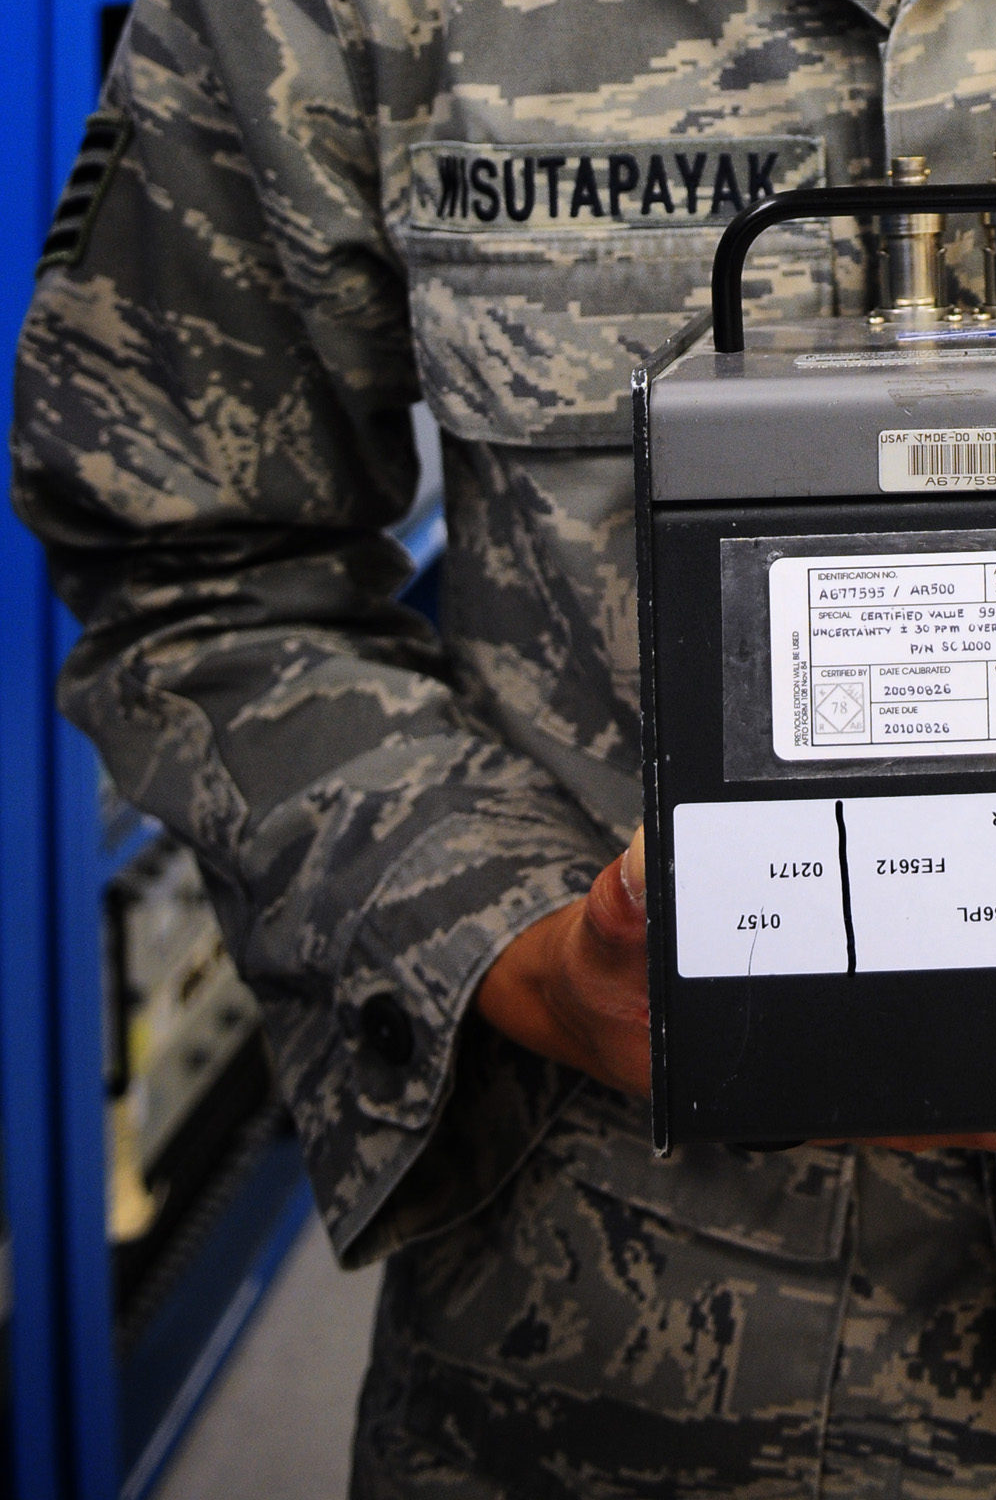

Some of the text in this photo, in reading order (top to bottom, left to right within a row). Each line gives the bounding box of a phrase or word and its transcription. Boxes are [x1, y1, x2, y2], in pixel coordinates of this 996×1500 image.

[881, 434, 909, 443] USAF
[918, 433, 970, 443] TMDE-DO
[817, 571, 898, 581] IDENTIFICATION NO.
[819, 583, 955, 600] A677595 / AR500
[818, 612, 851, 620] SPECIAL
[860, 608, 923, 621] CERTIFIED
[929, 608, 965, 619] VALUE
[813, 625, 891, 638] UNCERTAINTY
[914, 625, 929, 633] 30
[911, 643, 934, 654] P/N
[793, 652, 799, 660] BE
[821, 669, 856, 678] CERTIFIED
[880, 666, 951, 676] DATE CALIBRATED
[884, 684, 951, 696] 20090826
[831, 702, 848, 715] 78
[879, 706, 918, 715] DATE DUE
[885, 723, 950, 734] 20100826
[770, 862, 823, 878] 02171
[876, 858, 945, 875] FE5612
[737, 914, 781, 930] 0157
